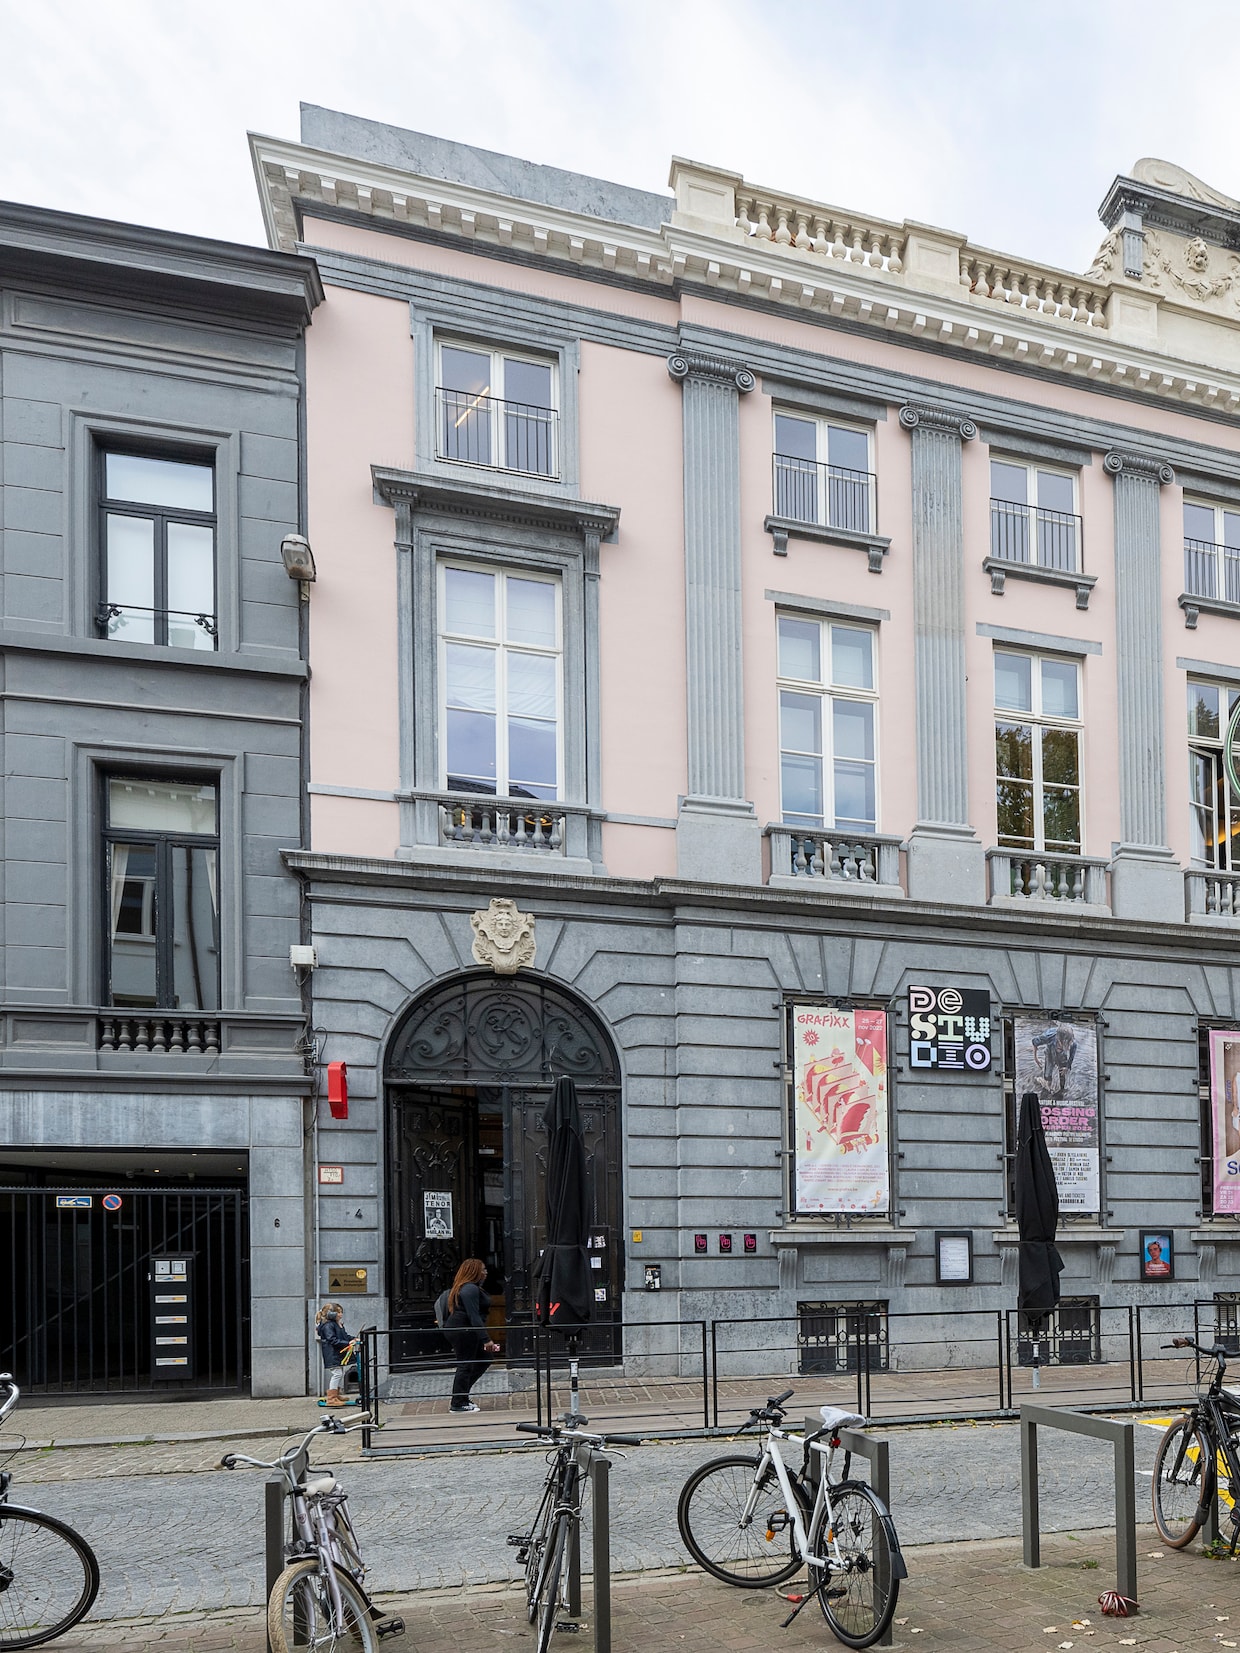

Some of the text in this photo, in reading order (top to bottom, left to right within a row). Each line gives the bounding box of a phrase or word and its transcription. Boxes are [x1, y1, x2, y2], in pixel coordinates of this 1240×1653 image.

[910, 1014, 990, 1042] STU
[1040, 1107, 1095, 1117] OSSING
[1041, 1116, 1088, 1125] ORDER
[274, 1218, 280, 1228] 6
